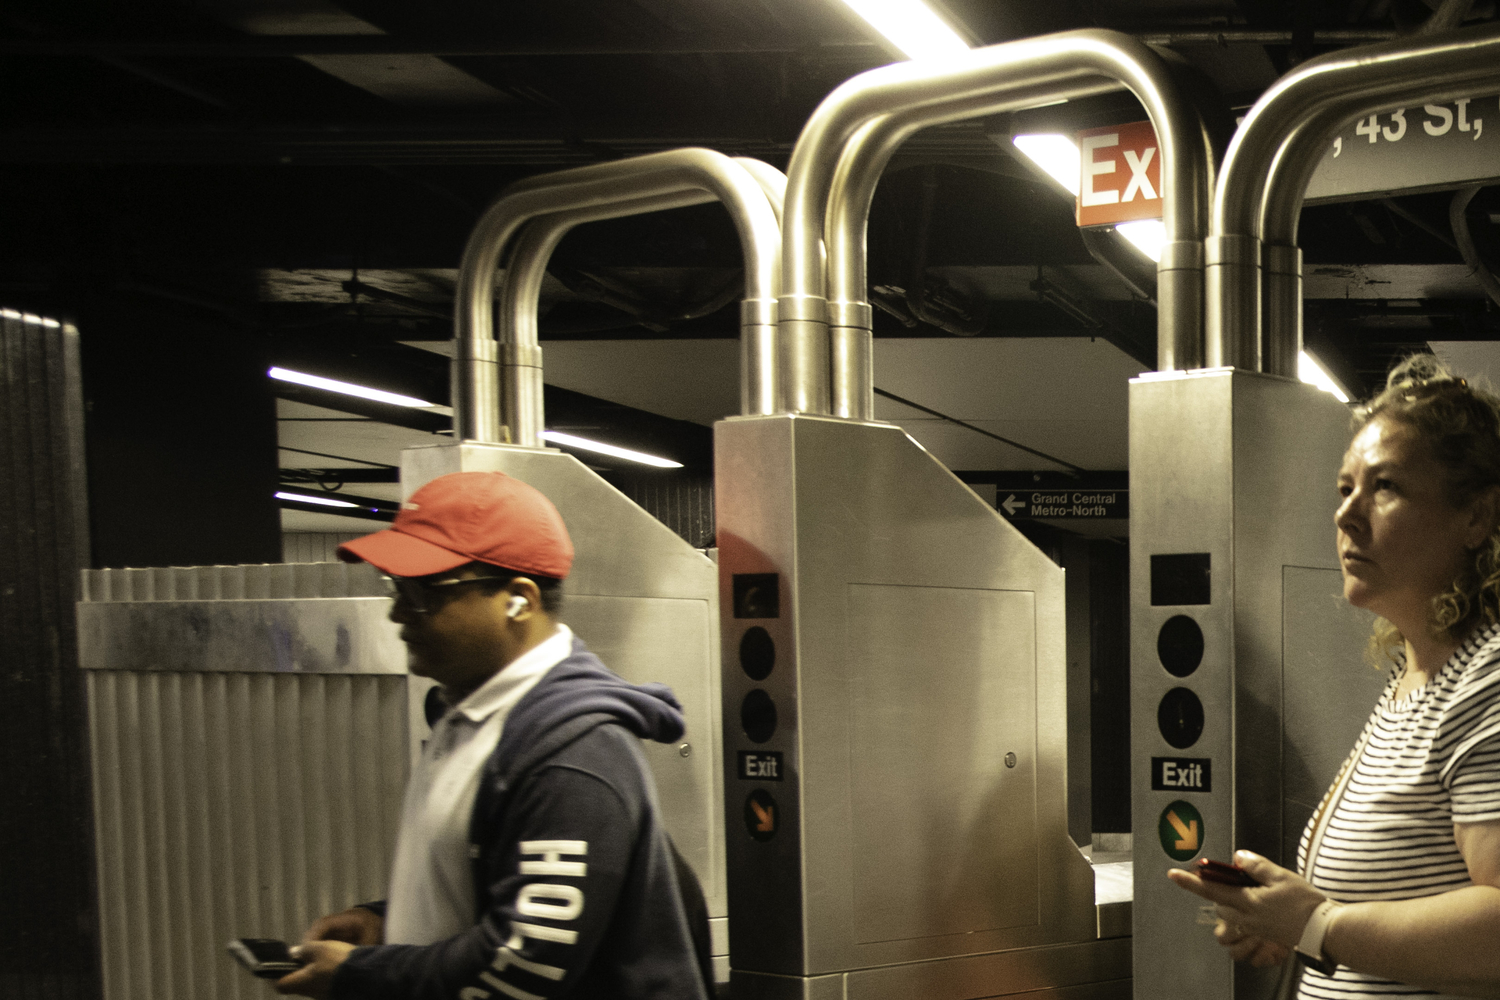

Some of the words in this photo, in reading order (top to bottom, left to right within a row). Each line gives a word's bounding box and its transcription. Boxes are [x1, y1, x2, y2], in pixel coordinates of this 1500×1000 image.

[1356, 107, 1407, 143] 43
[1423, 98, 1483, 141] St,
[1081, 133, 1165, 208] Ex
[1031, 492, 1068, 504] Grand
[1072, 492, 1116, 504] Central
[1031, 505, 1107, 516] Metro-North
[745, 754, 778, 778] Exit
[1162, 761, 1203, 788] Exit
